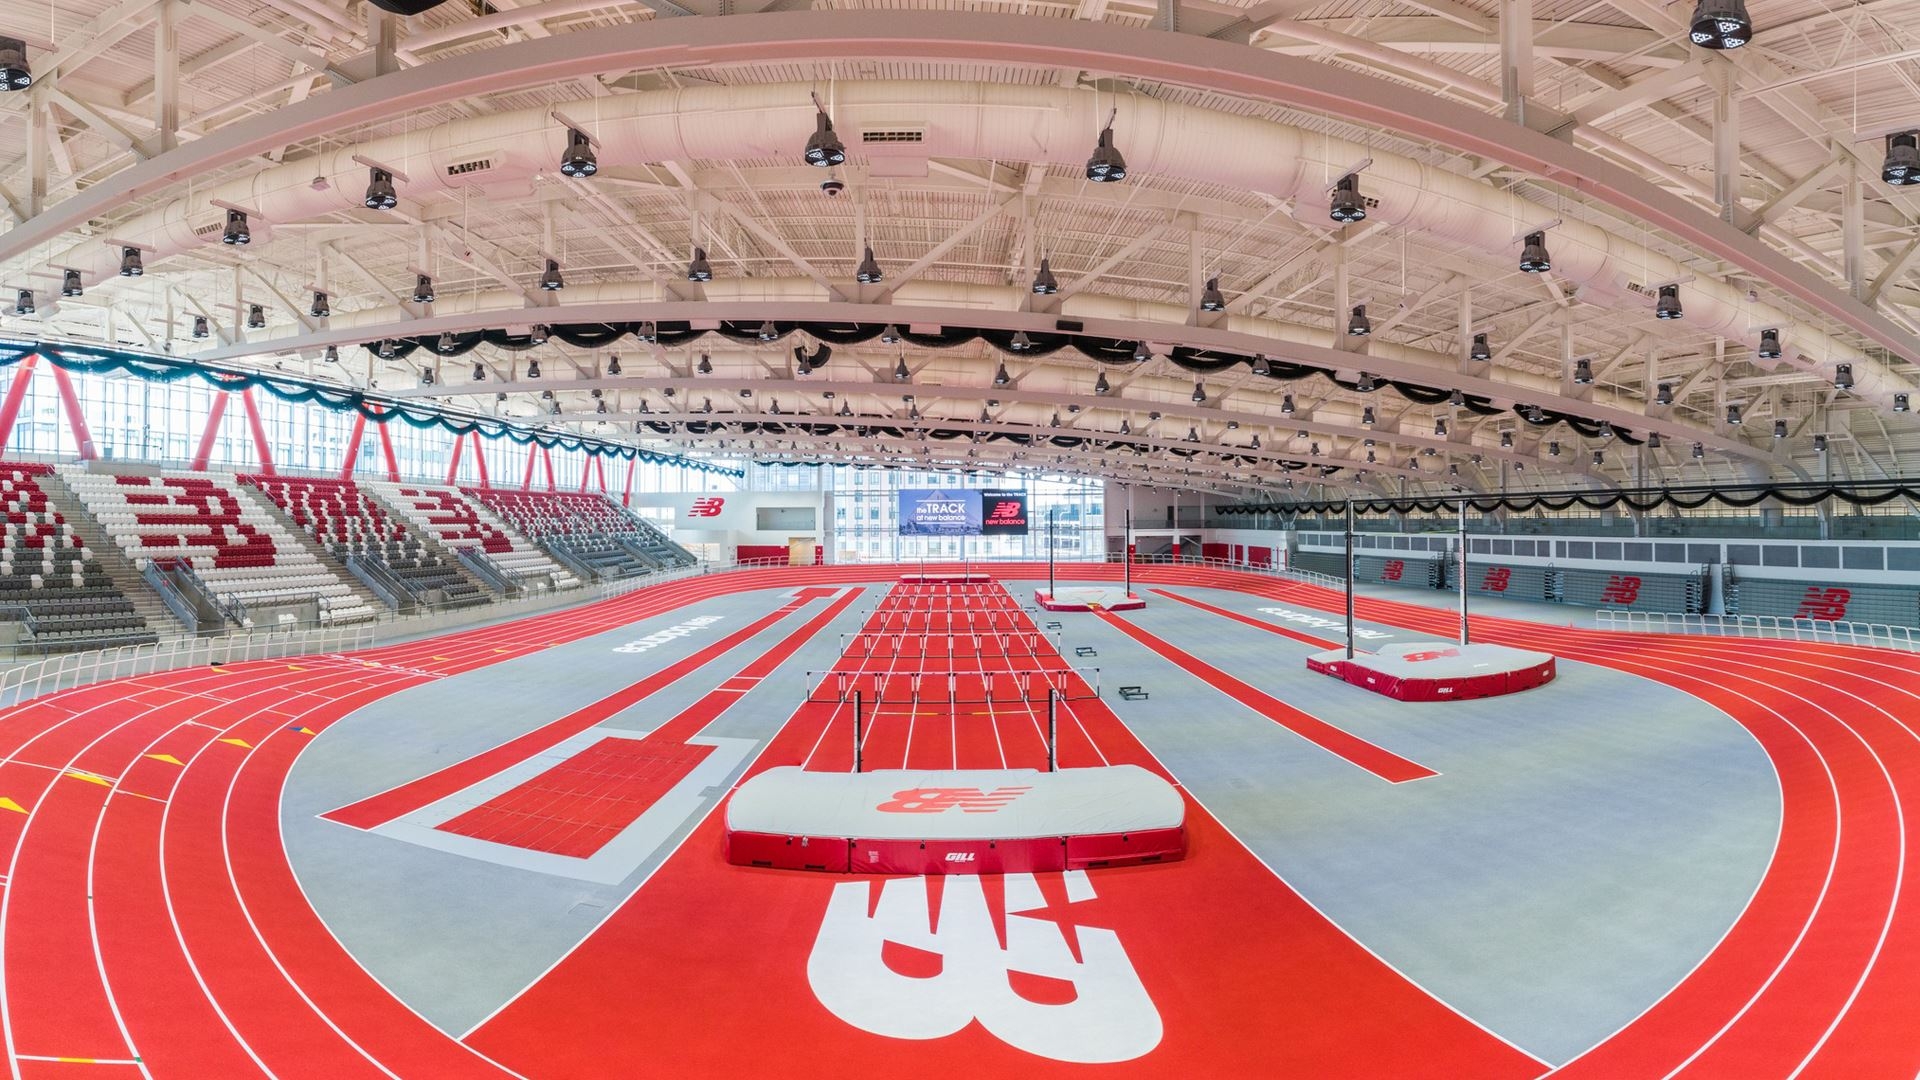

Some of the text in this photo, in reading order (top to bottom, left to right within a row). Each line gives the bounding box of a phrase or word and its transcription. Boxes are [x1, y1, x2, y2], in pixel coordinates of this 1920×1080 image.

[687, 497, 725, 517] NB
[916, 503, 966, 514] the TRACK
[991, 502, 1022, 518] NB
[916, 514, 924, 522] at
[938, 514, 966, 522] balance
[1380, 560, 1405, 581] NB
[1481, 567, 1513, 592] NB
[1600, 575, 1642, 605] NB
[1794, 586, 1852, 621] NB
[876, 787, 1034, 813] NB
[945, 852, 976, 862] GILL
